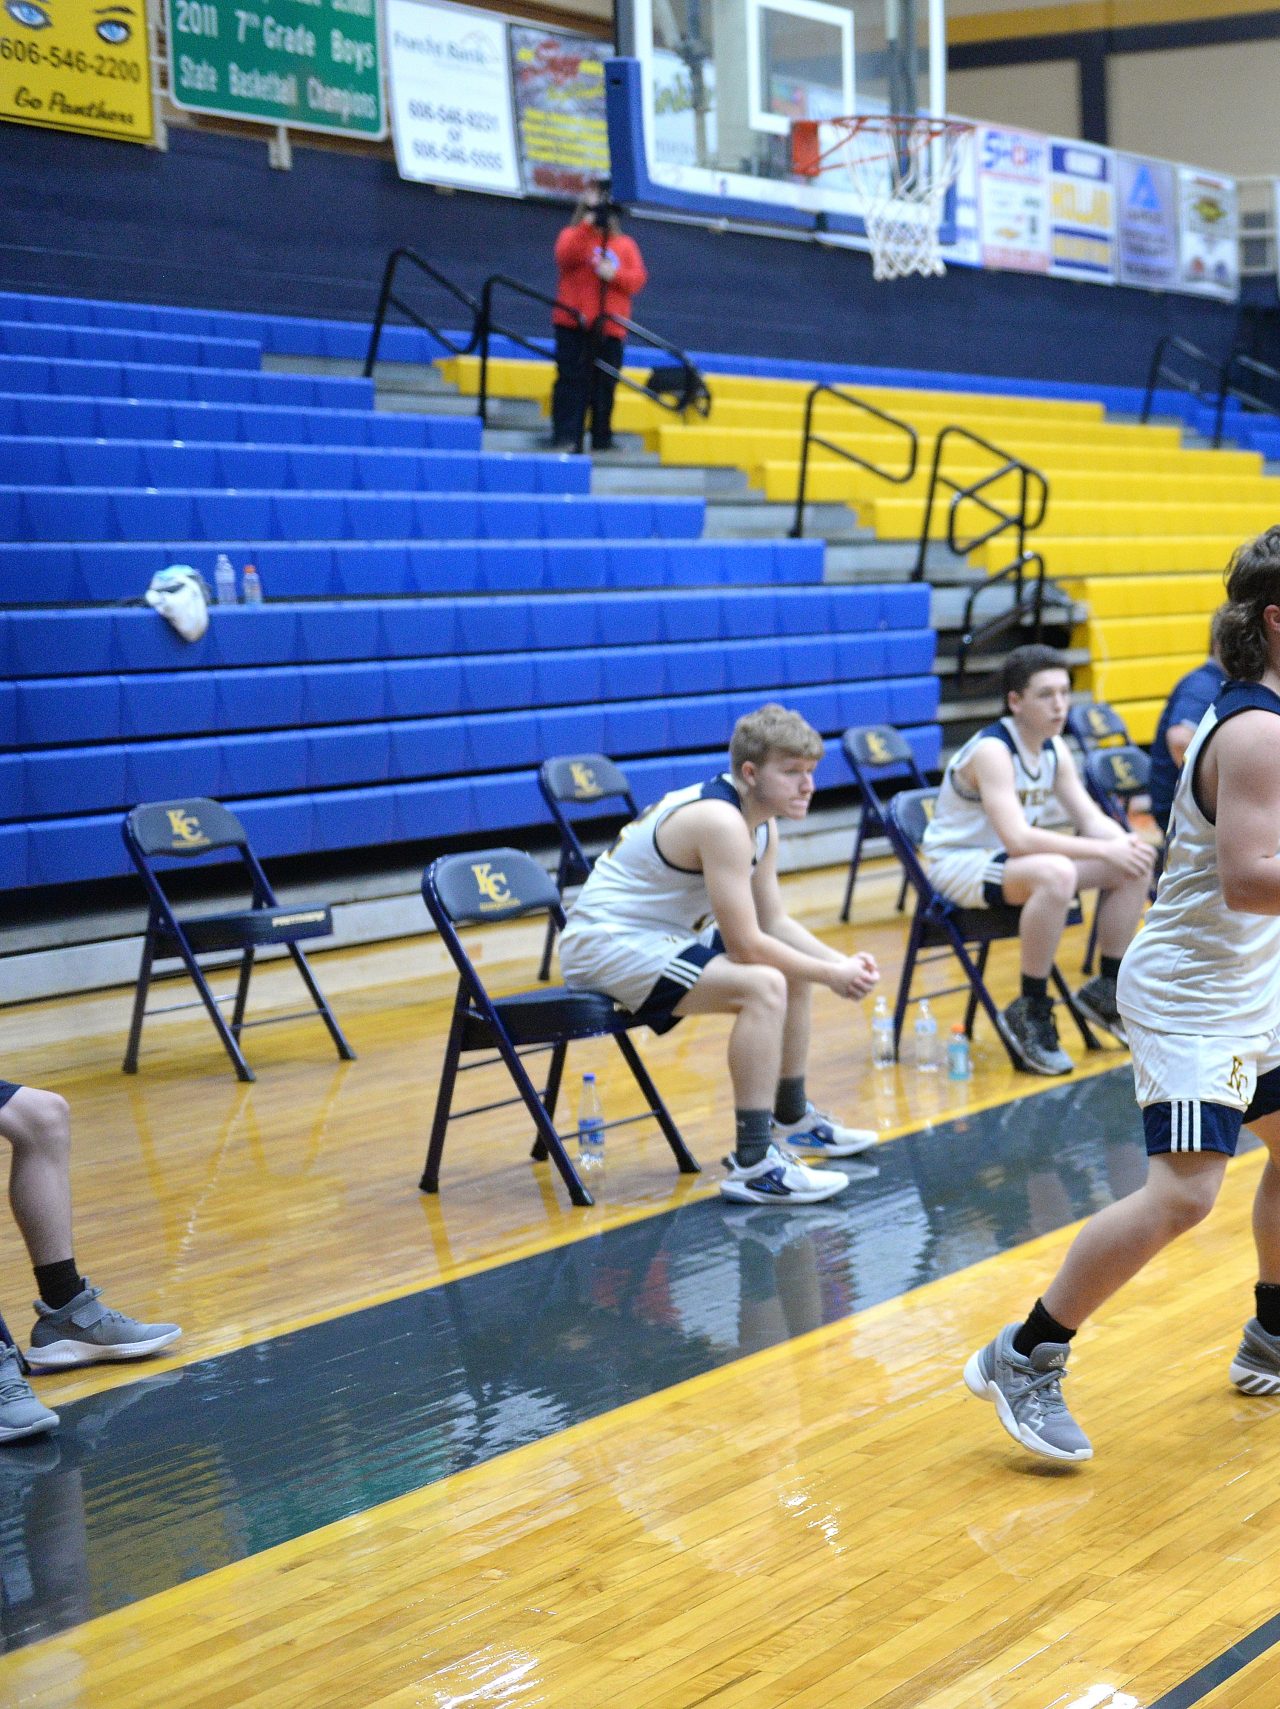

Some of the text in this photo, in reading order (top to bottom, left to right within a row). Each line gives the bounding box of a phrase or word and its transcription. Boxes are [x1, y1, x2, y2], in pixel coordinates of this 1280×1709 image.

[176, 0, 219, 38] 2011
[262, 15, 316, 57] Grade
[330, 28, 375, 74] Boys
[0, 37, 141, 83] 606-546-2200
[179, 54, 218, 92] State
[228, 61, 299, 107] Basketball
[14, 86, 134, 125] Go Panthers
[166, 809, 203, 841] KC
[471, 863, 511, 902] KC
